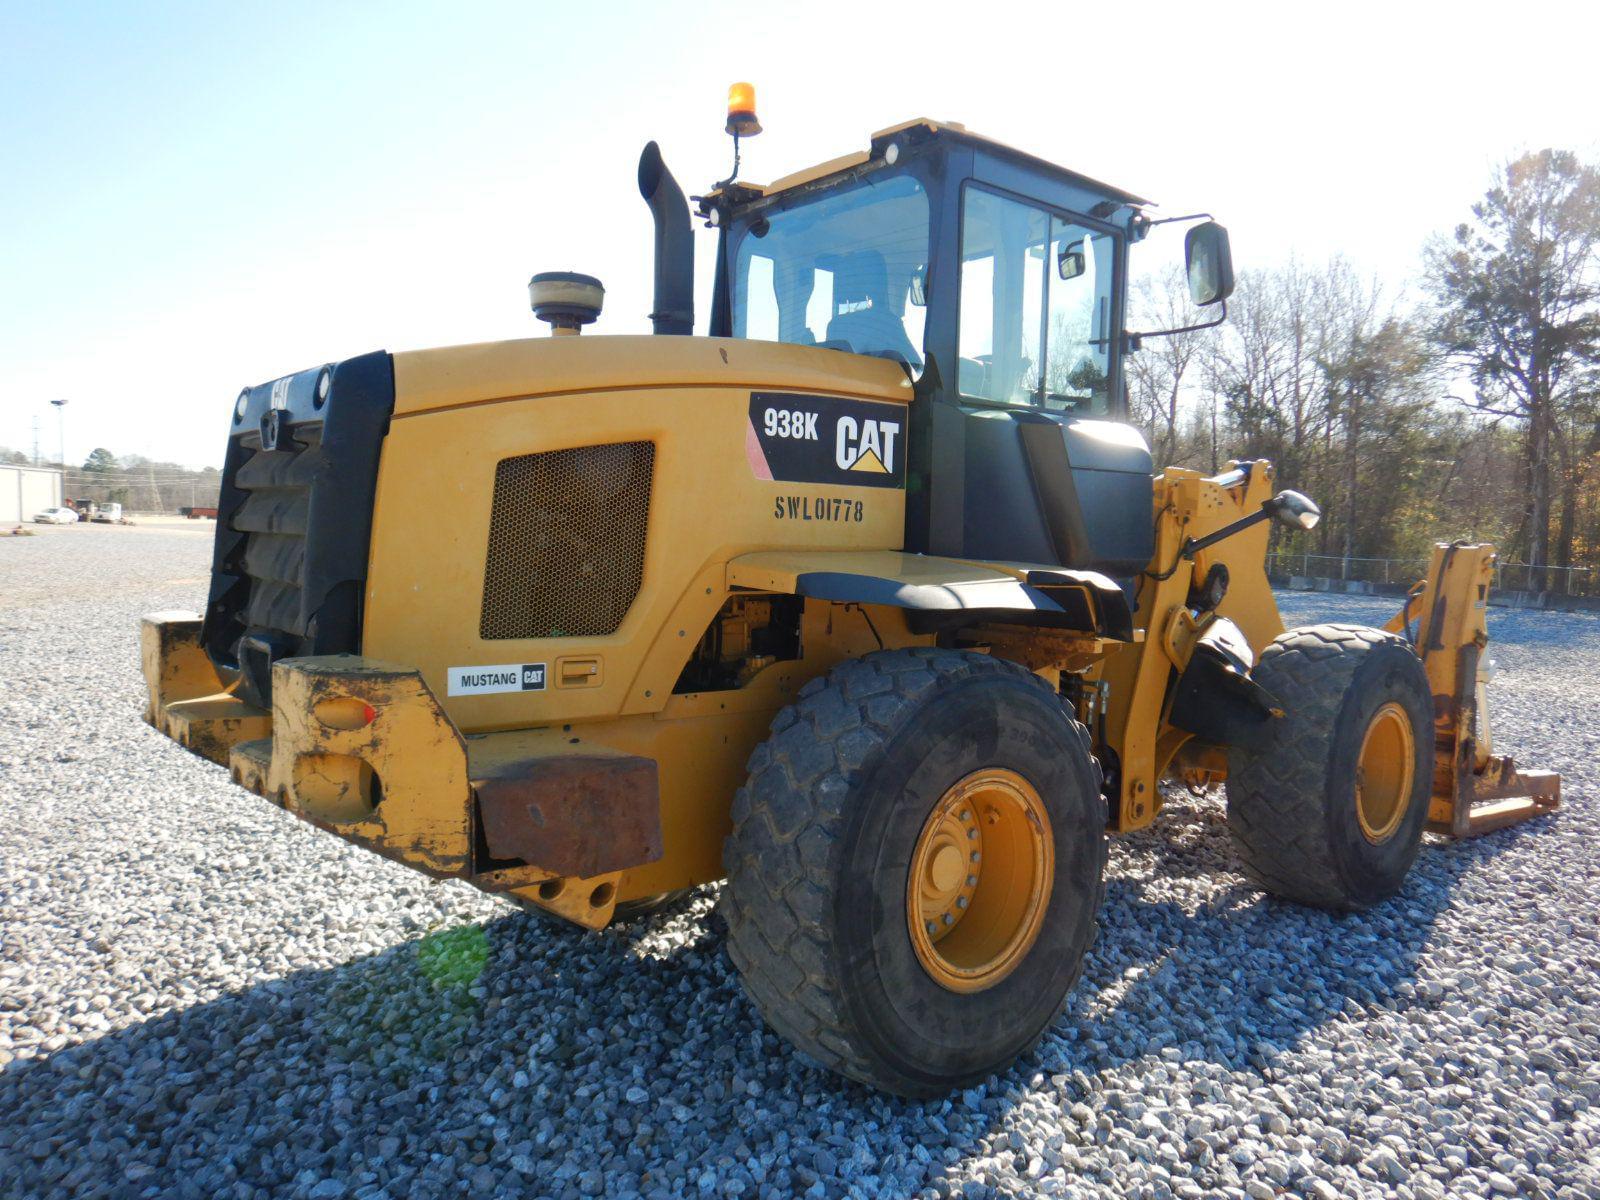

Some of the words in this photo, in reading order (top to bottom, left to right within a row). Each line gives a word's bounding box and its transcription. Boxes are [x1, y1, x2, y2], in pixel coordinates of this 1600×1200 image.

[764, 407, 819, 440] 938K
[836, 416, 899, 474] CAT
[774, 496, 863, 522] SWL01778
[461, 673, 516, 687] MUSTANG
[524, 670, 543, 683] CAT
